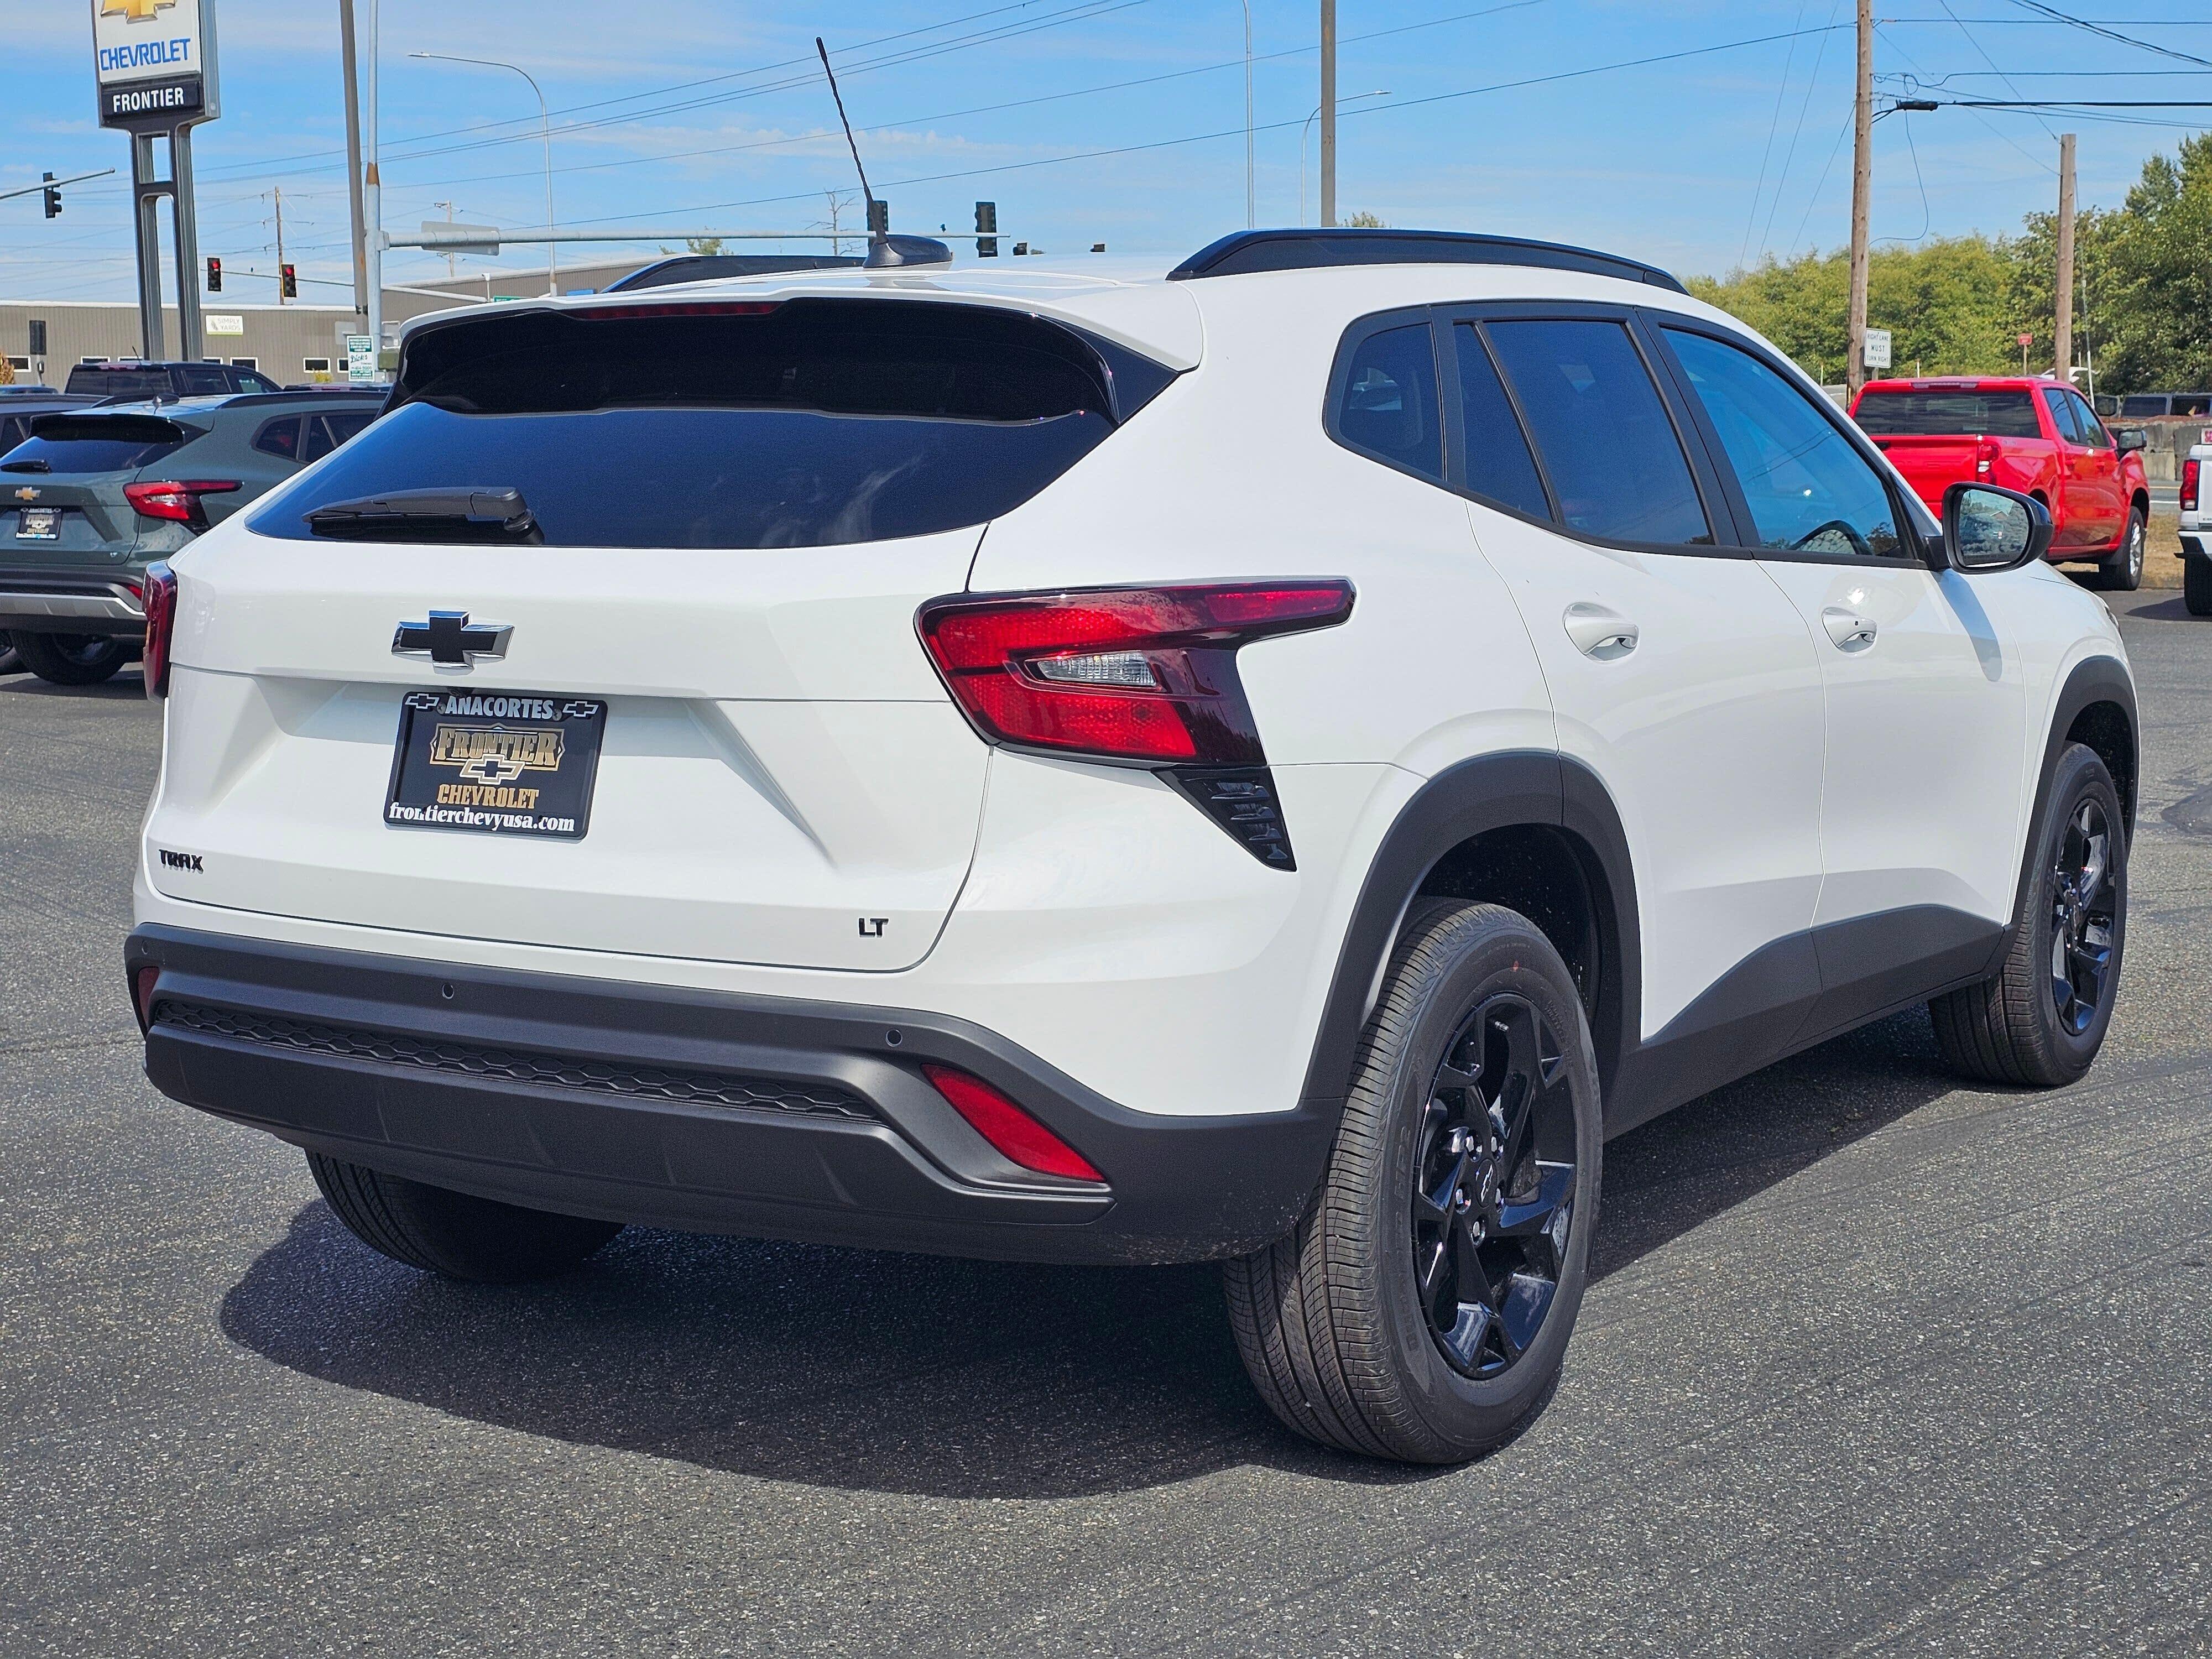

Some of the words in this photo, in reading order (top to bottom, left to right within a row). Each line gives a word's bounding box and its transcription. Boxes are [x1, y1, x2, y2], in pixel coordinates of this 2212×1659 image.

[100, 38, 191, 71] CHEVROLET
[113, 87, 184, 113] FRONTIER
[1871, 344, 1885, 352] MUST
[444, 696, 554, 719] ANACORTES
[435, 728, 559, 767] FRONTIER
[436, 784, 540, 810] CHEVROLET
[389, 802, 575, 832] frontierchevyusa.com
[159, 849, 204, 873] TRAX
[858, 917, 889, 938] LT
